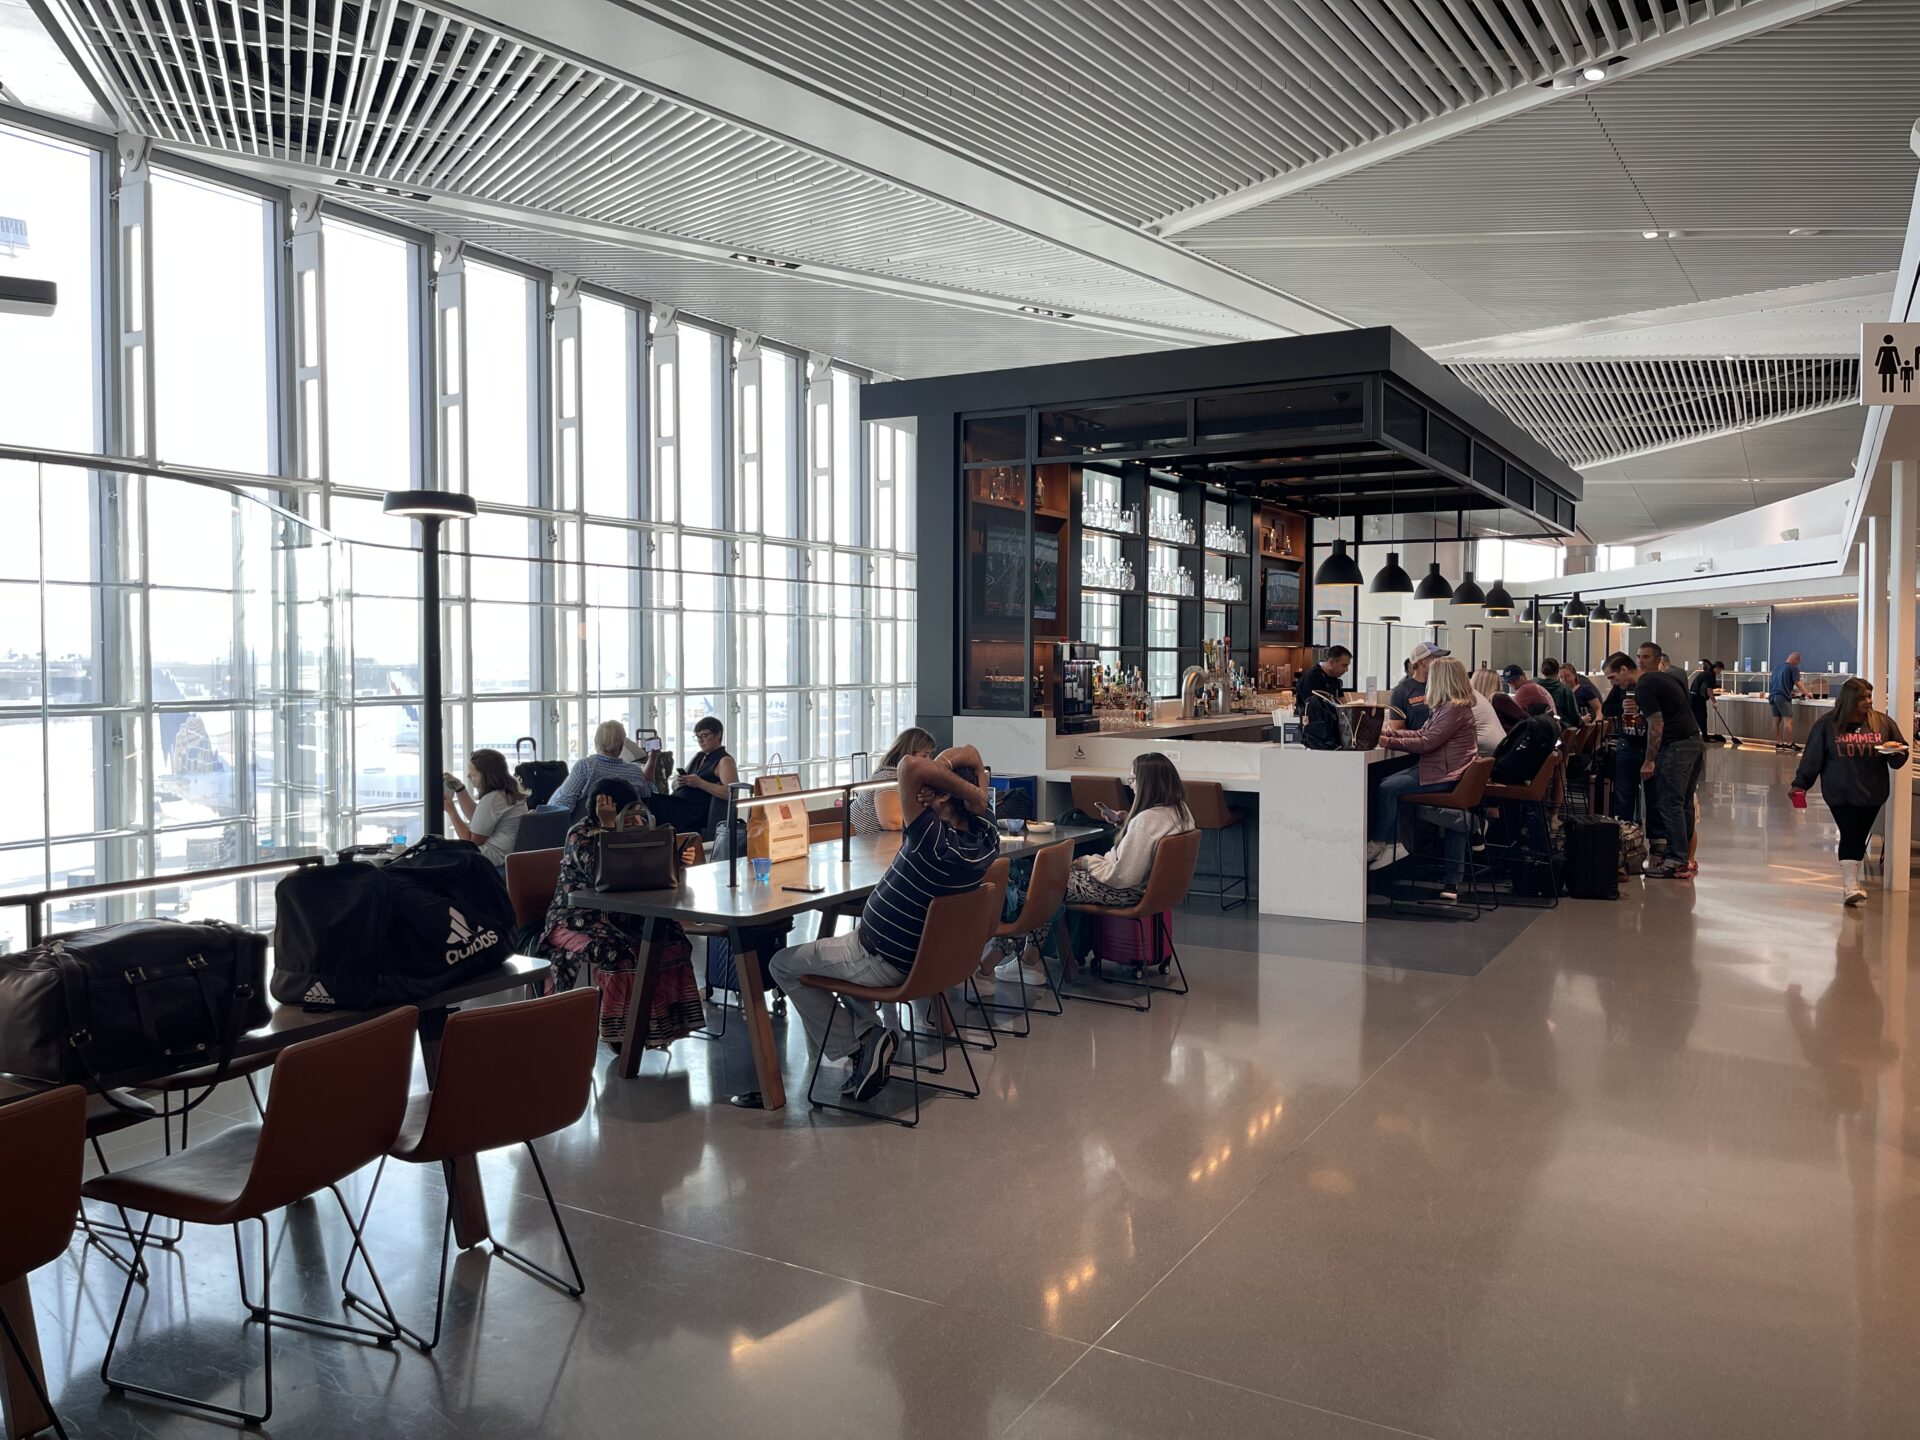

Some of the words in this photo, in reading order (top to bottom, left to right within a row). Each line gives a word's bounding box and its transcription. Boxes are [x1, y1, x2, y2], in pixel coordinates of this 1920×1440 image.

[1835, 732, 1882, 743] SUMMER
[1836, 743, 1878, 757] LOVI
[445, 926, 498, 965] adidas
[304, 995, 336, 1004] adidas
